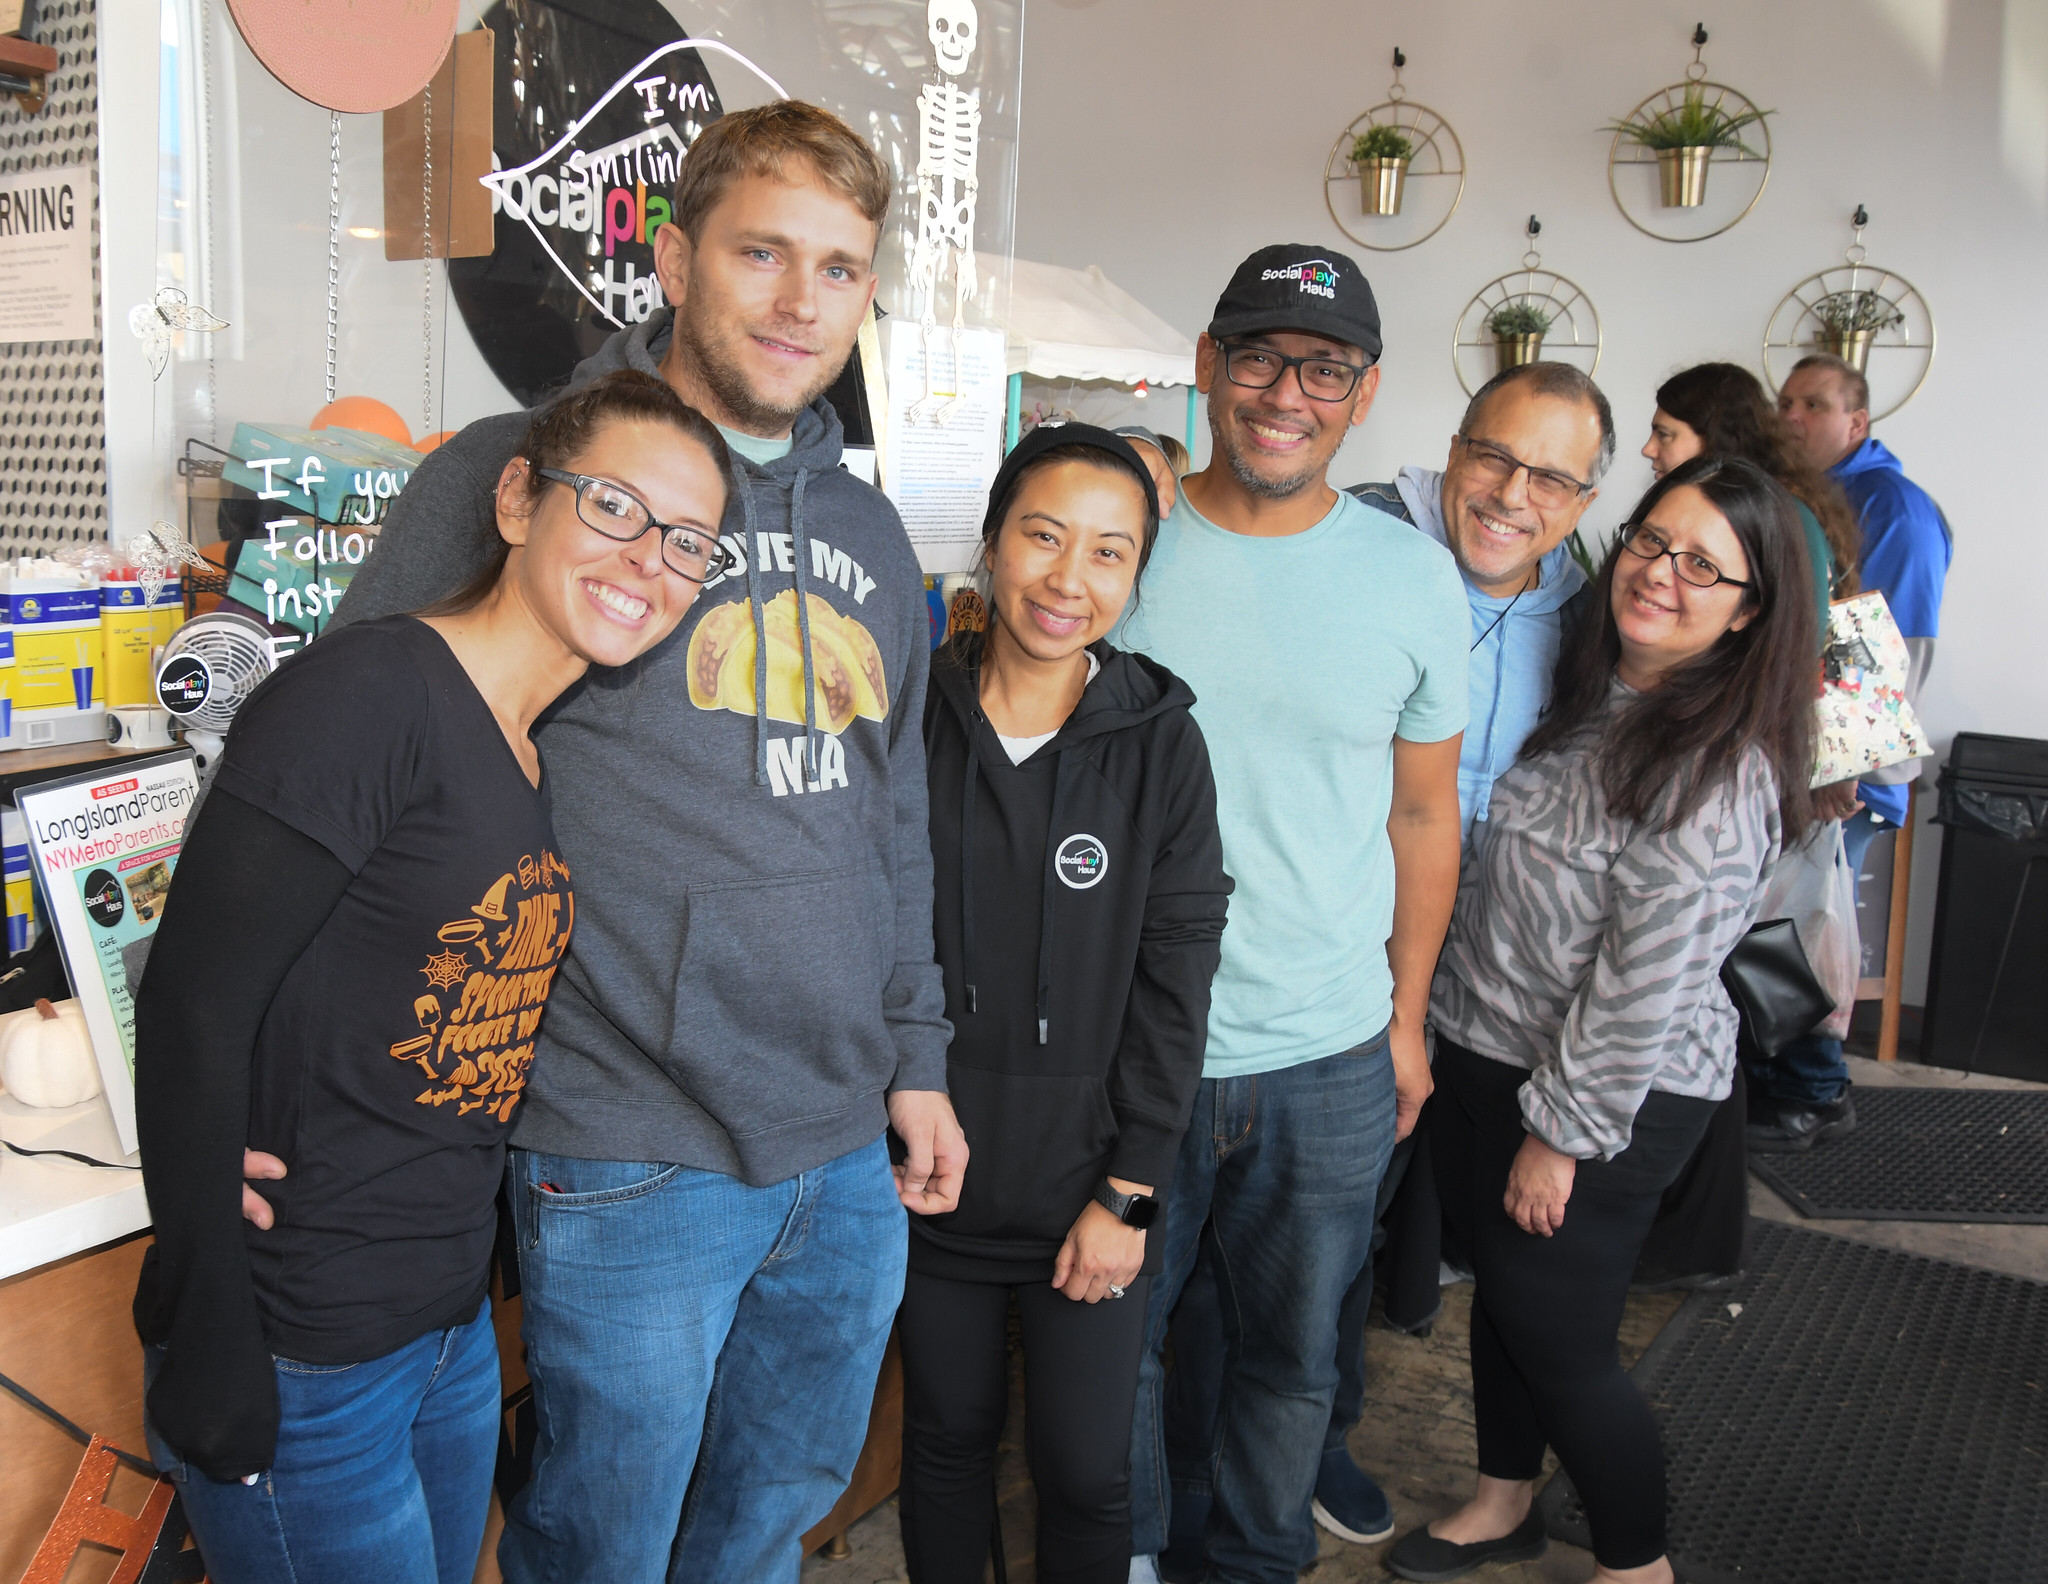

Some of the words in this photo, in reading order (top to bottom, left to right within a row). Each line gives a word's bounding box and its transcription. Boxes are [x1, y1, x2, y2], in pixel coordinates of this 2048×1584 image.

[633, 75, 710, 119] I'm
[491, 150, 675, 258] ocialpla
[1299, 280, 1335, 299] Haus
[246, 455, 326, 500] If
[262, 518, 374, 565] Follo
[809, 537, 877, 606] MY
[262, 577, 346, 626] inst
[183, 689, 204, 700] Haus
[96, 789, 107, 798] AS
[108, 784, 124, 794] SEEN
[124, 781, 135, 790] IN
[145, 781, 166, 792] NASSAU
[166, 776, 186, 789] EDITION
[36, 780, 197, 845] LongIslandParent
[1077, 865, 1096, 874] Haus
[106, 901, 123, 913] Haus
